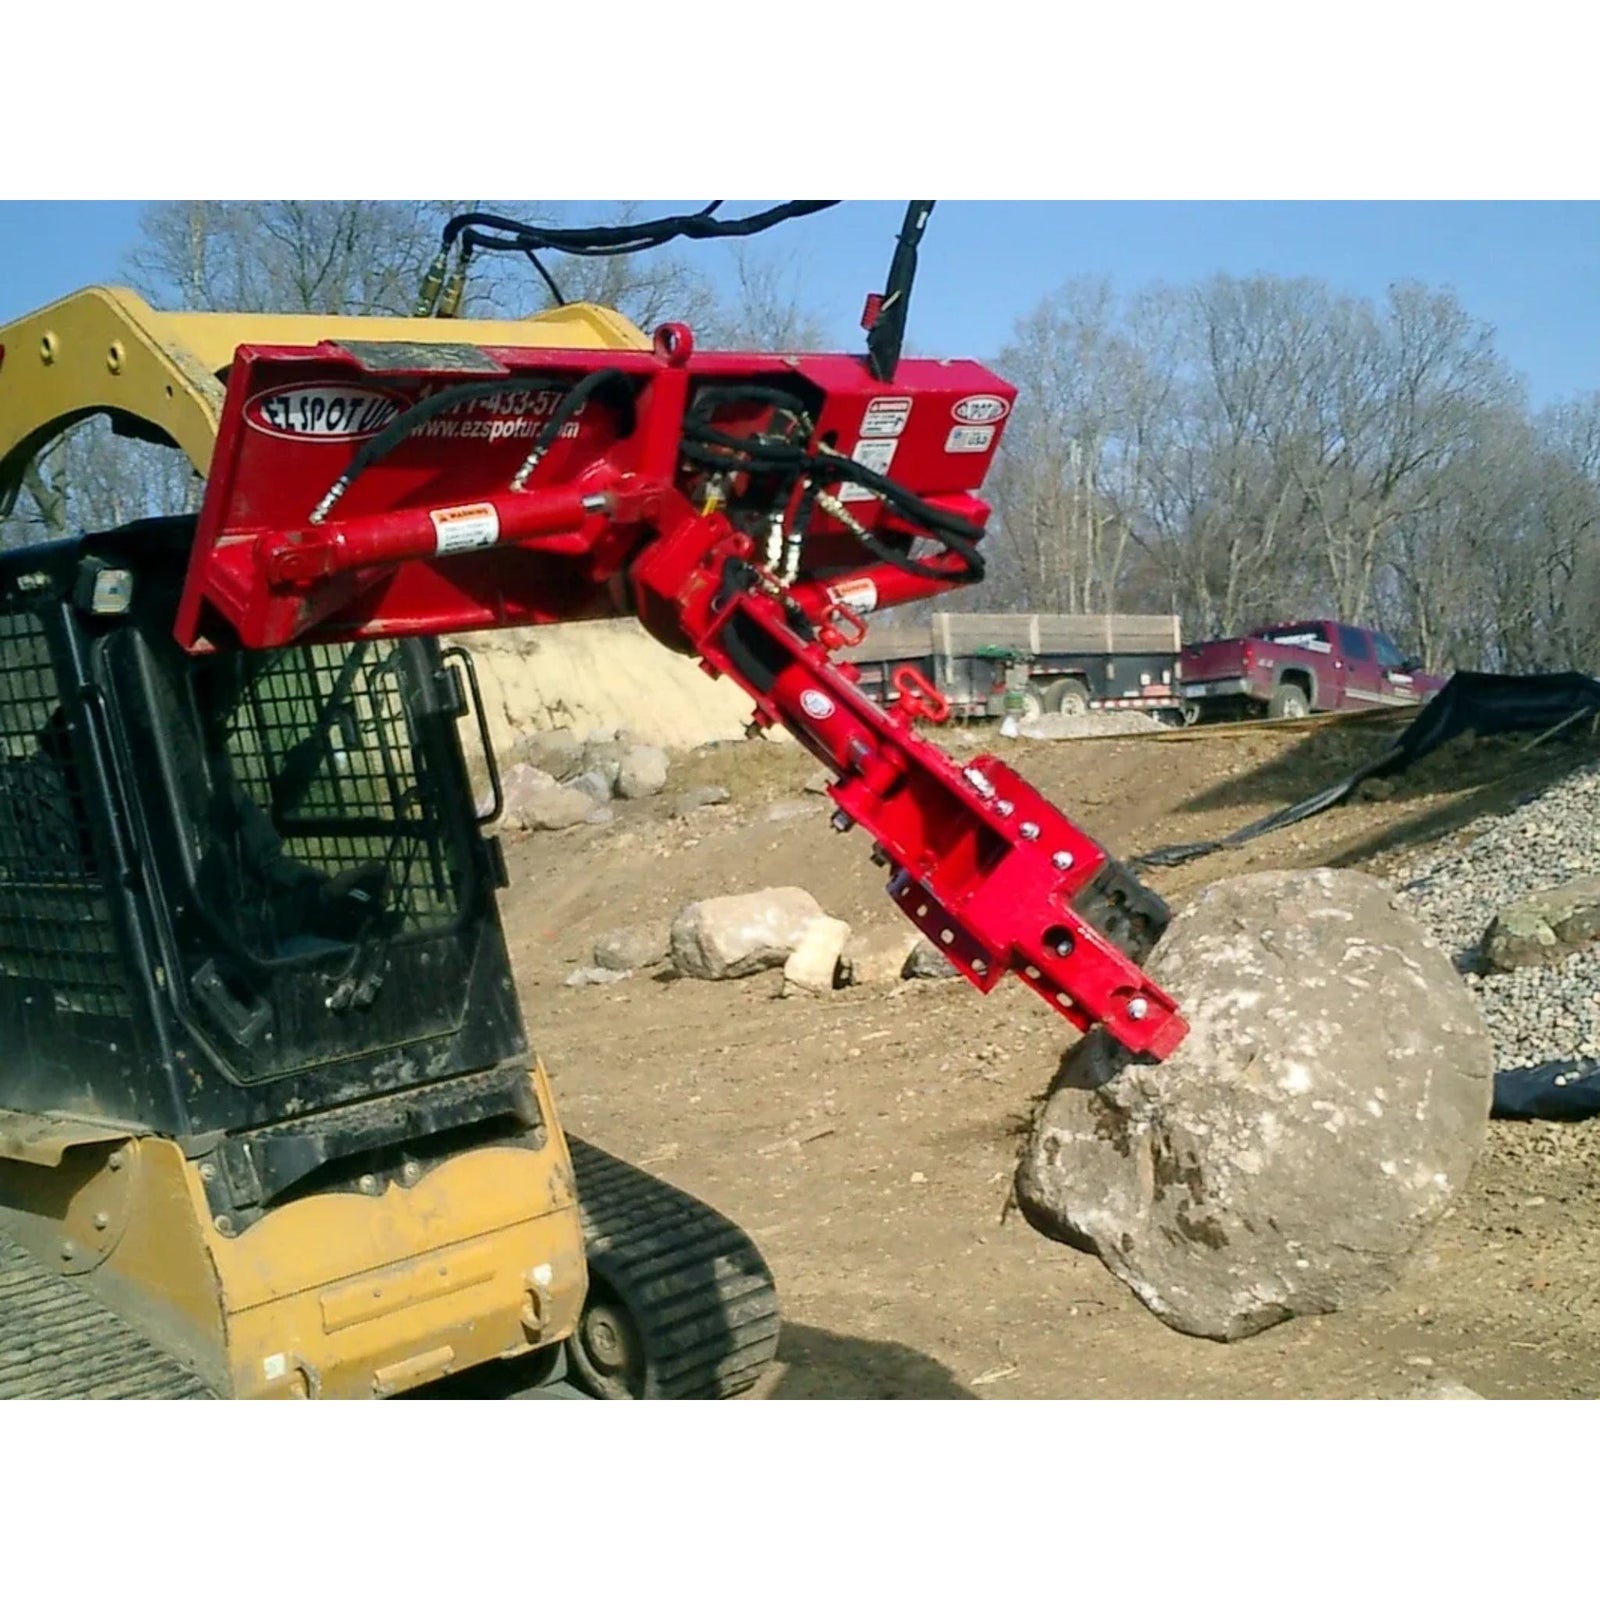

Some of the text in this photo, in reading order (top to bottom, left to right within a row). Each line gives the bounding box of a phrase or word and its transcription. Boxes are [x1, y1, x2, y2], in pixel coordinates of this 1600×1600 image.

[261, 396, 296, 432] EZ
[299, 396, 363, 432] SPOT
[409, 416, 580, 443] www.ezspotur.m
